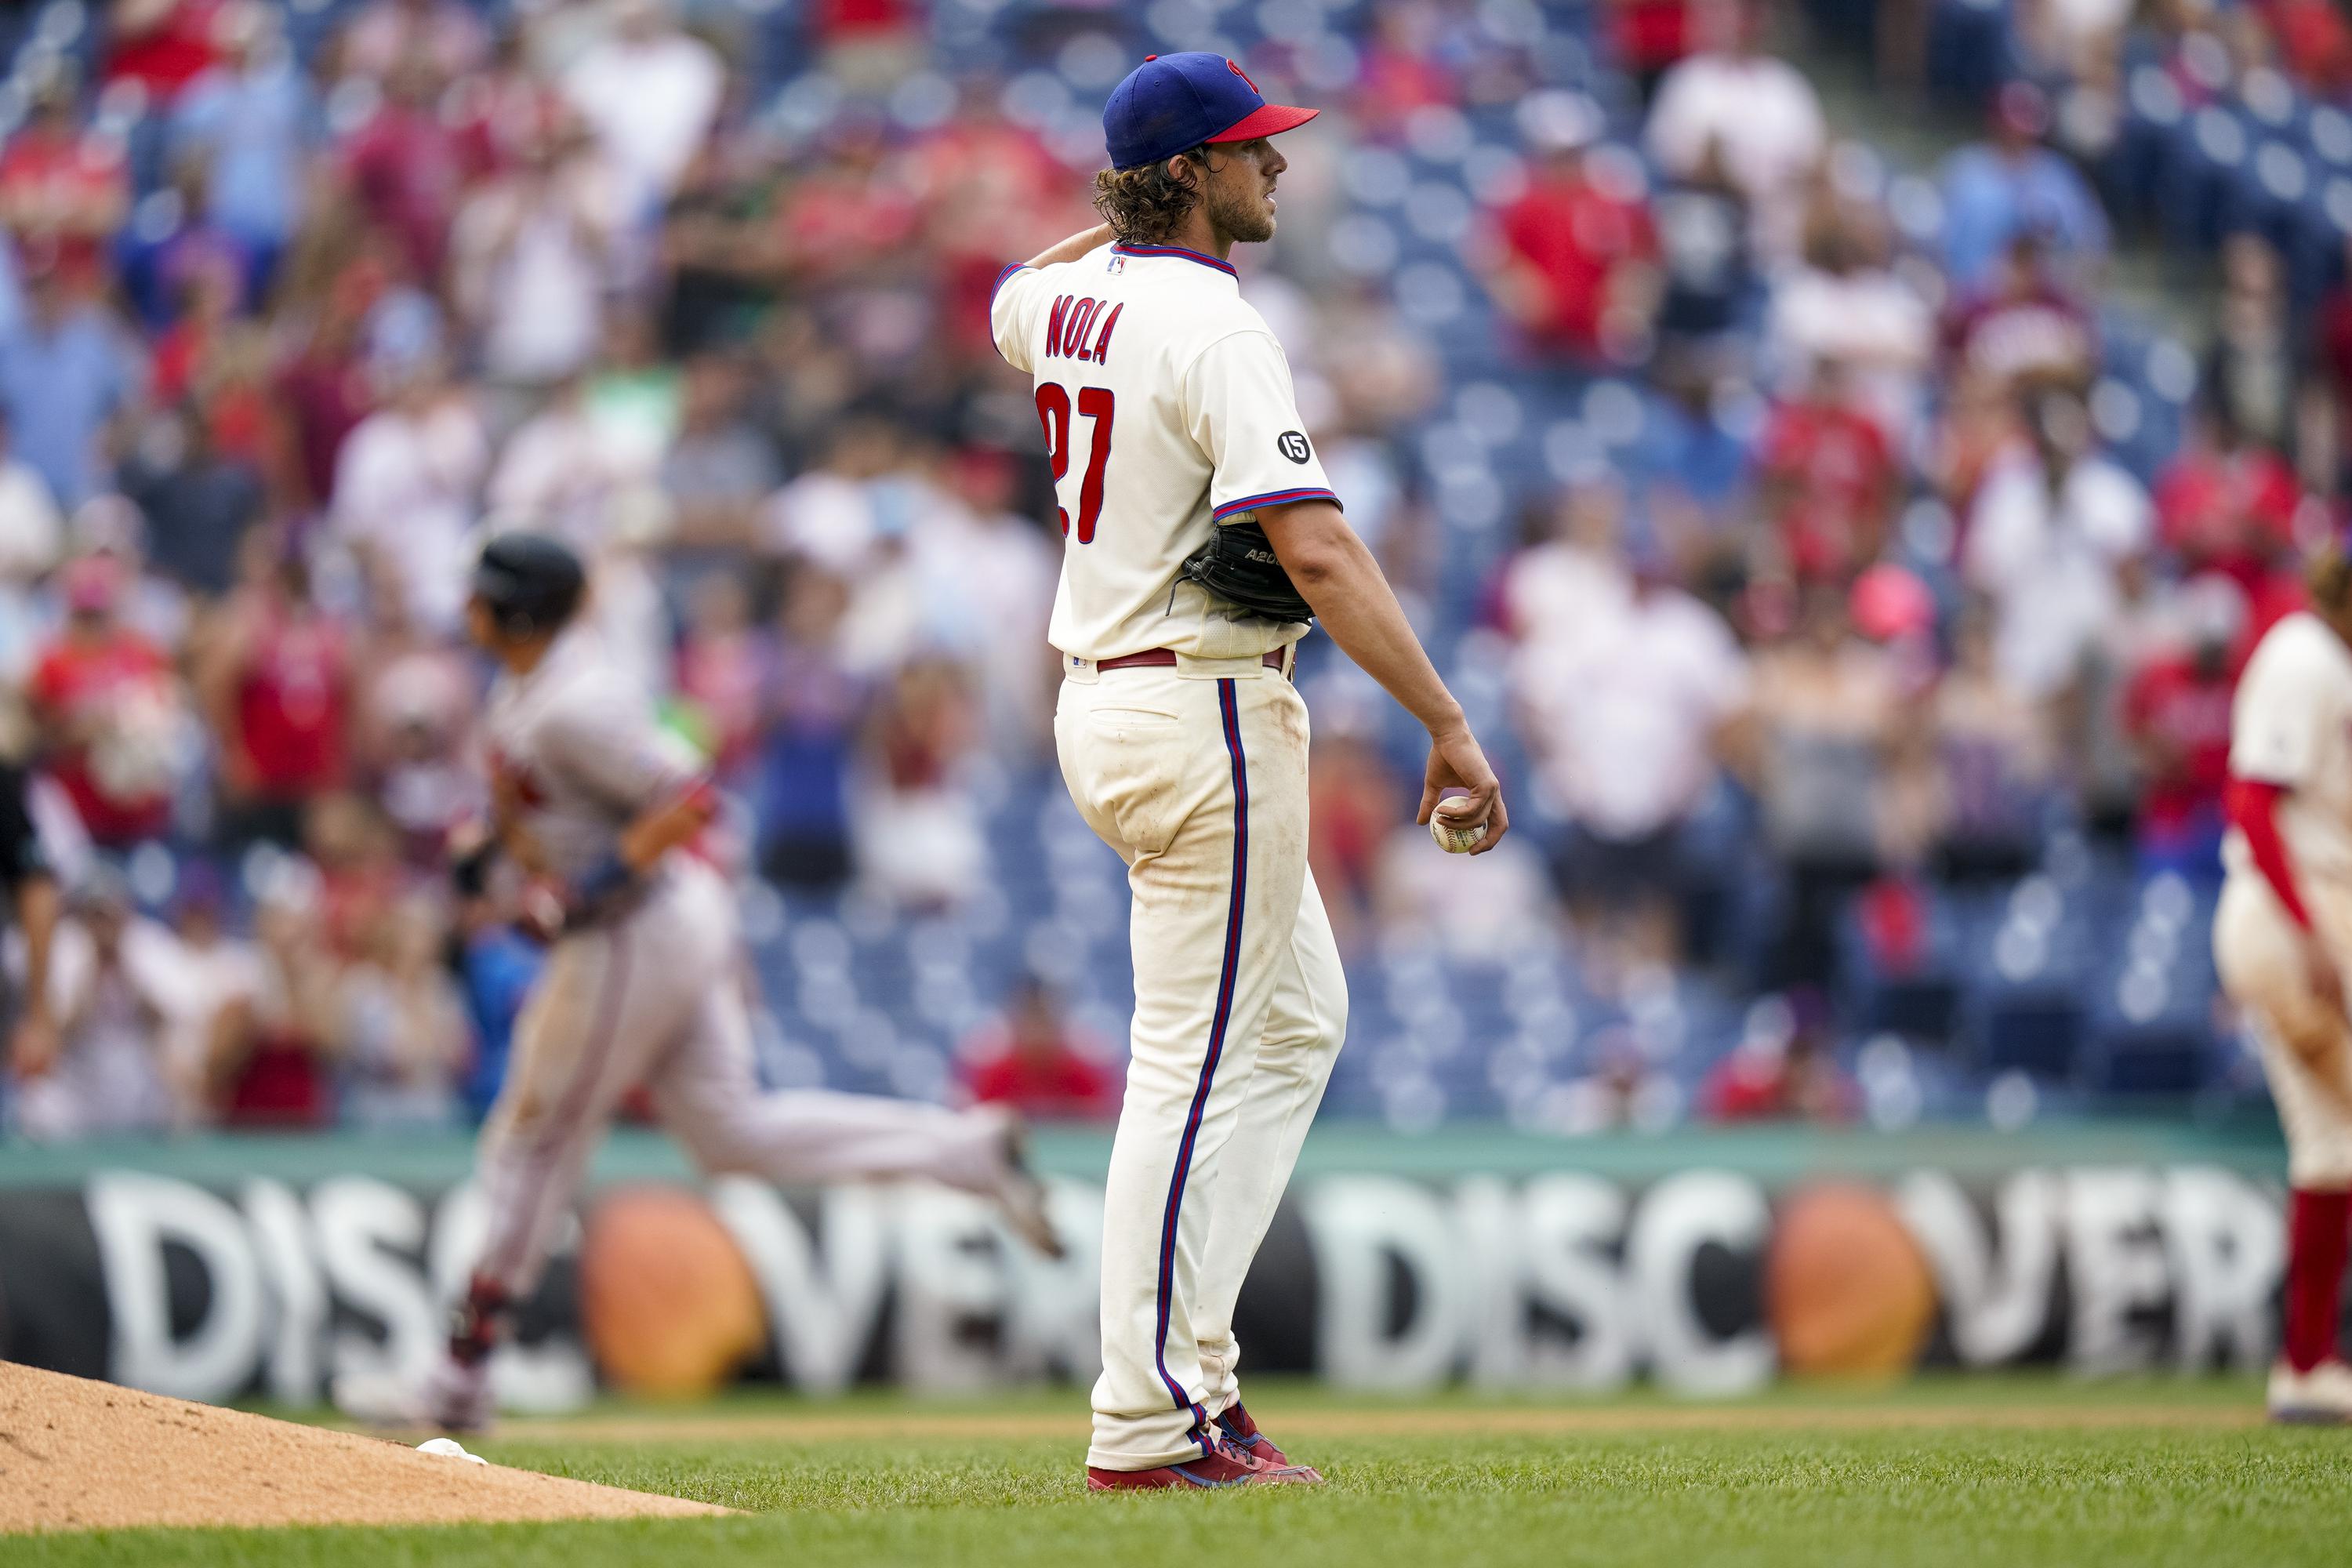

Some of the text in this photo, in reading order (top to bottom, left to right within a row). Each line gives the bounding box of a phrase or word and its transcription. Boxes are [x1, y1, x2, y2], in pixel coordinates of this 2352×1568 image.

[1046, 295, 1123, 365] NOLA
[1281, 435, 1307, 459] 15
[1244, 548, 1280, 565] A20
[1303, 1168, 2286, 1397] DISCOVER
